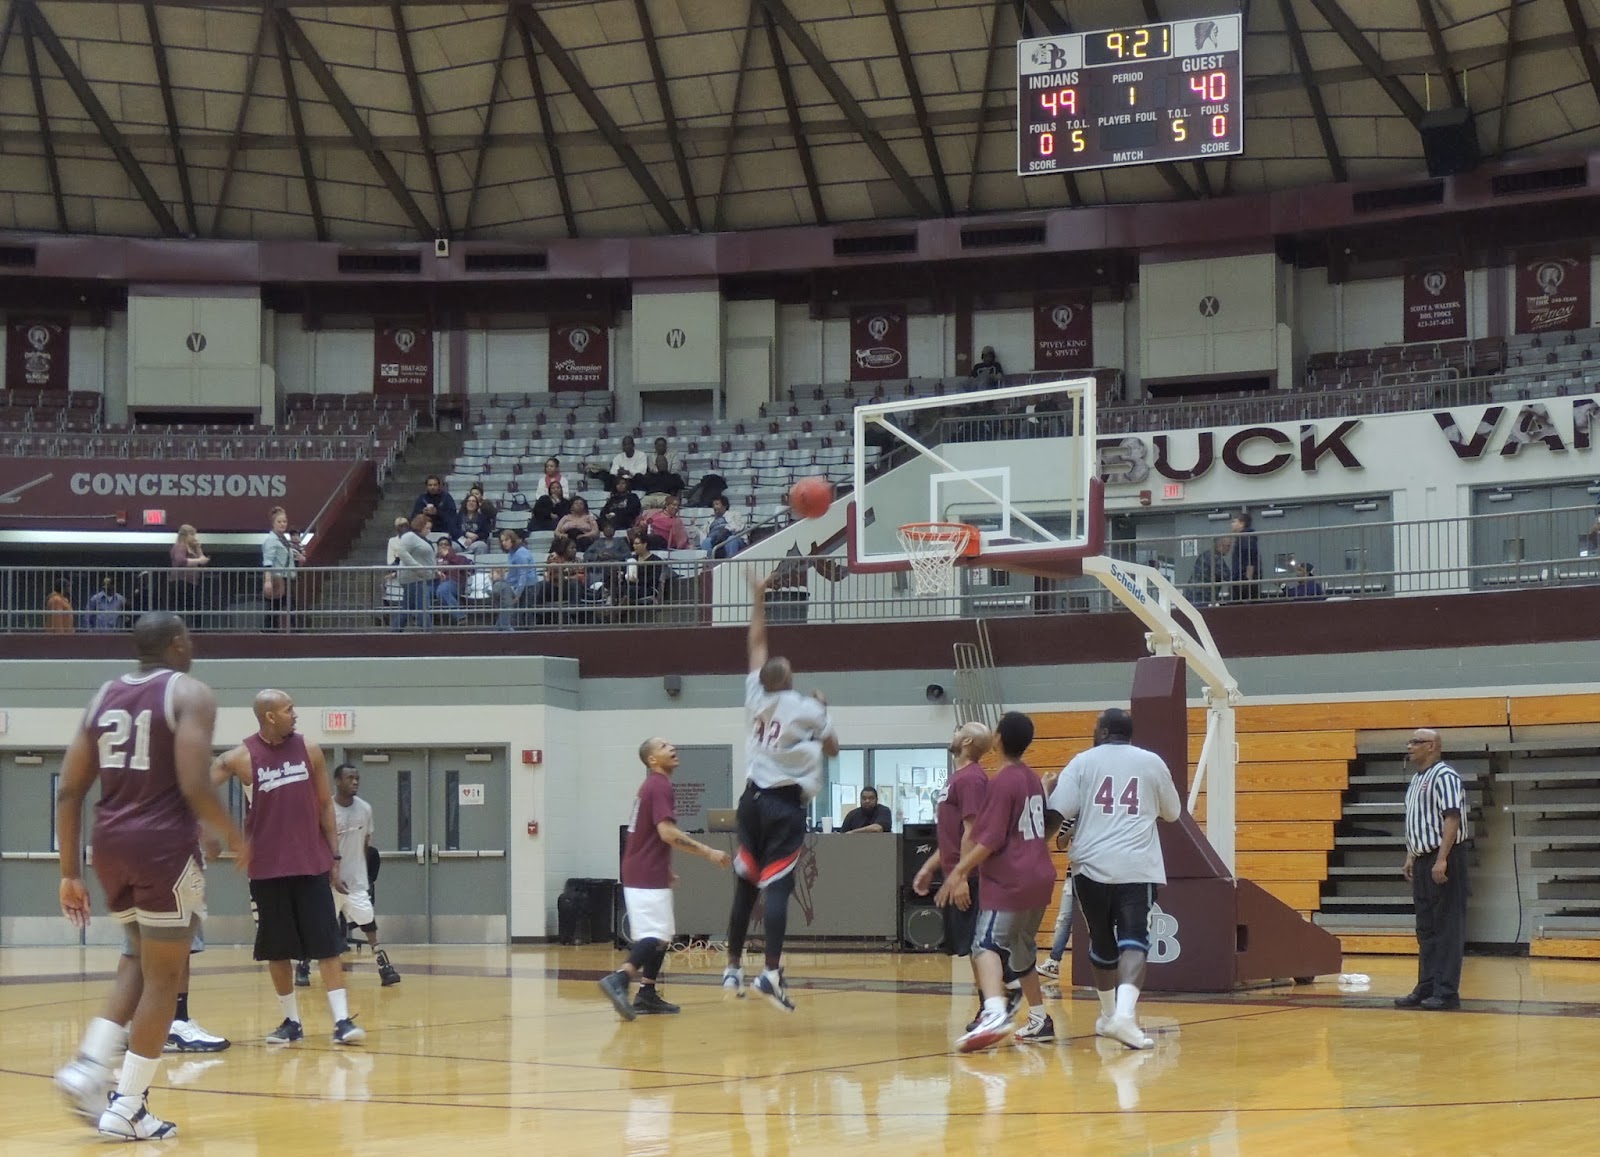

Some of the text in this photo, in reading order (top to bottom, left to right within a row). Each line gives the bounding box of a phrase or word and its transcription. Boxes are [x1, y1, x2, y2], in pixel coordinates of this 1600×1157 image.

[1107, 29, 1168, 58] 9:21
[1182, 55, 1225, 72] GUEST
[1029, 71, 1079, 89] INDIANS
[1112, 72, 1144, 84] PERIOD
[1190, 72, 1226, 101] 40
[1041, 89, 1076, 117] 49
[1129, 87, 1135, 106] 1
[1098, 111, 1158, 126] PLAYER FOUL
[1168, 108, 1191, 119] T.O.L.
[1201, 104, 1229, 115] FOULS
[1029, 122, 1057, 133] FOULS
[1067, 119, 1090, 130] T.O.L.
[1172, 119, 1186, 142] 5
[1212, 115, 1226, 137] 0
[1040, 133, 1053, 155] 0
[1072, 130, 1085, 152] 5
[1201, 142, 1230, 153] SCORE
[1029, 159, 1057, 171] SCORE
[1113, 150, 1144, 162] MATCH
[1203, 298, 1215, 316] X
[191, 333, 202, 352] V
[666, 330, 685, 348] W
[1097, 420, 1363, 484] BUCK
[70, 472, 287, 497] CONCESSIONS
[1164, 484, 1179, 497] EXIT
[1110, 563, 1146, 604] Schelde
[328, 713, 347, 728] EXIT
[98, 709, 151, 770] 21
[1094, 775, 1141, 817] 44
[1018, 794, 1046, 841] 48
